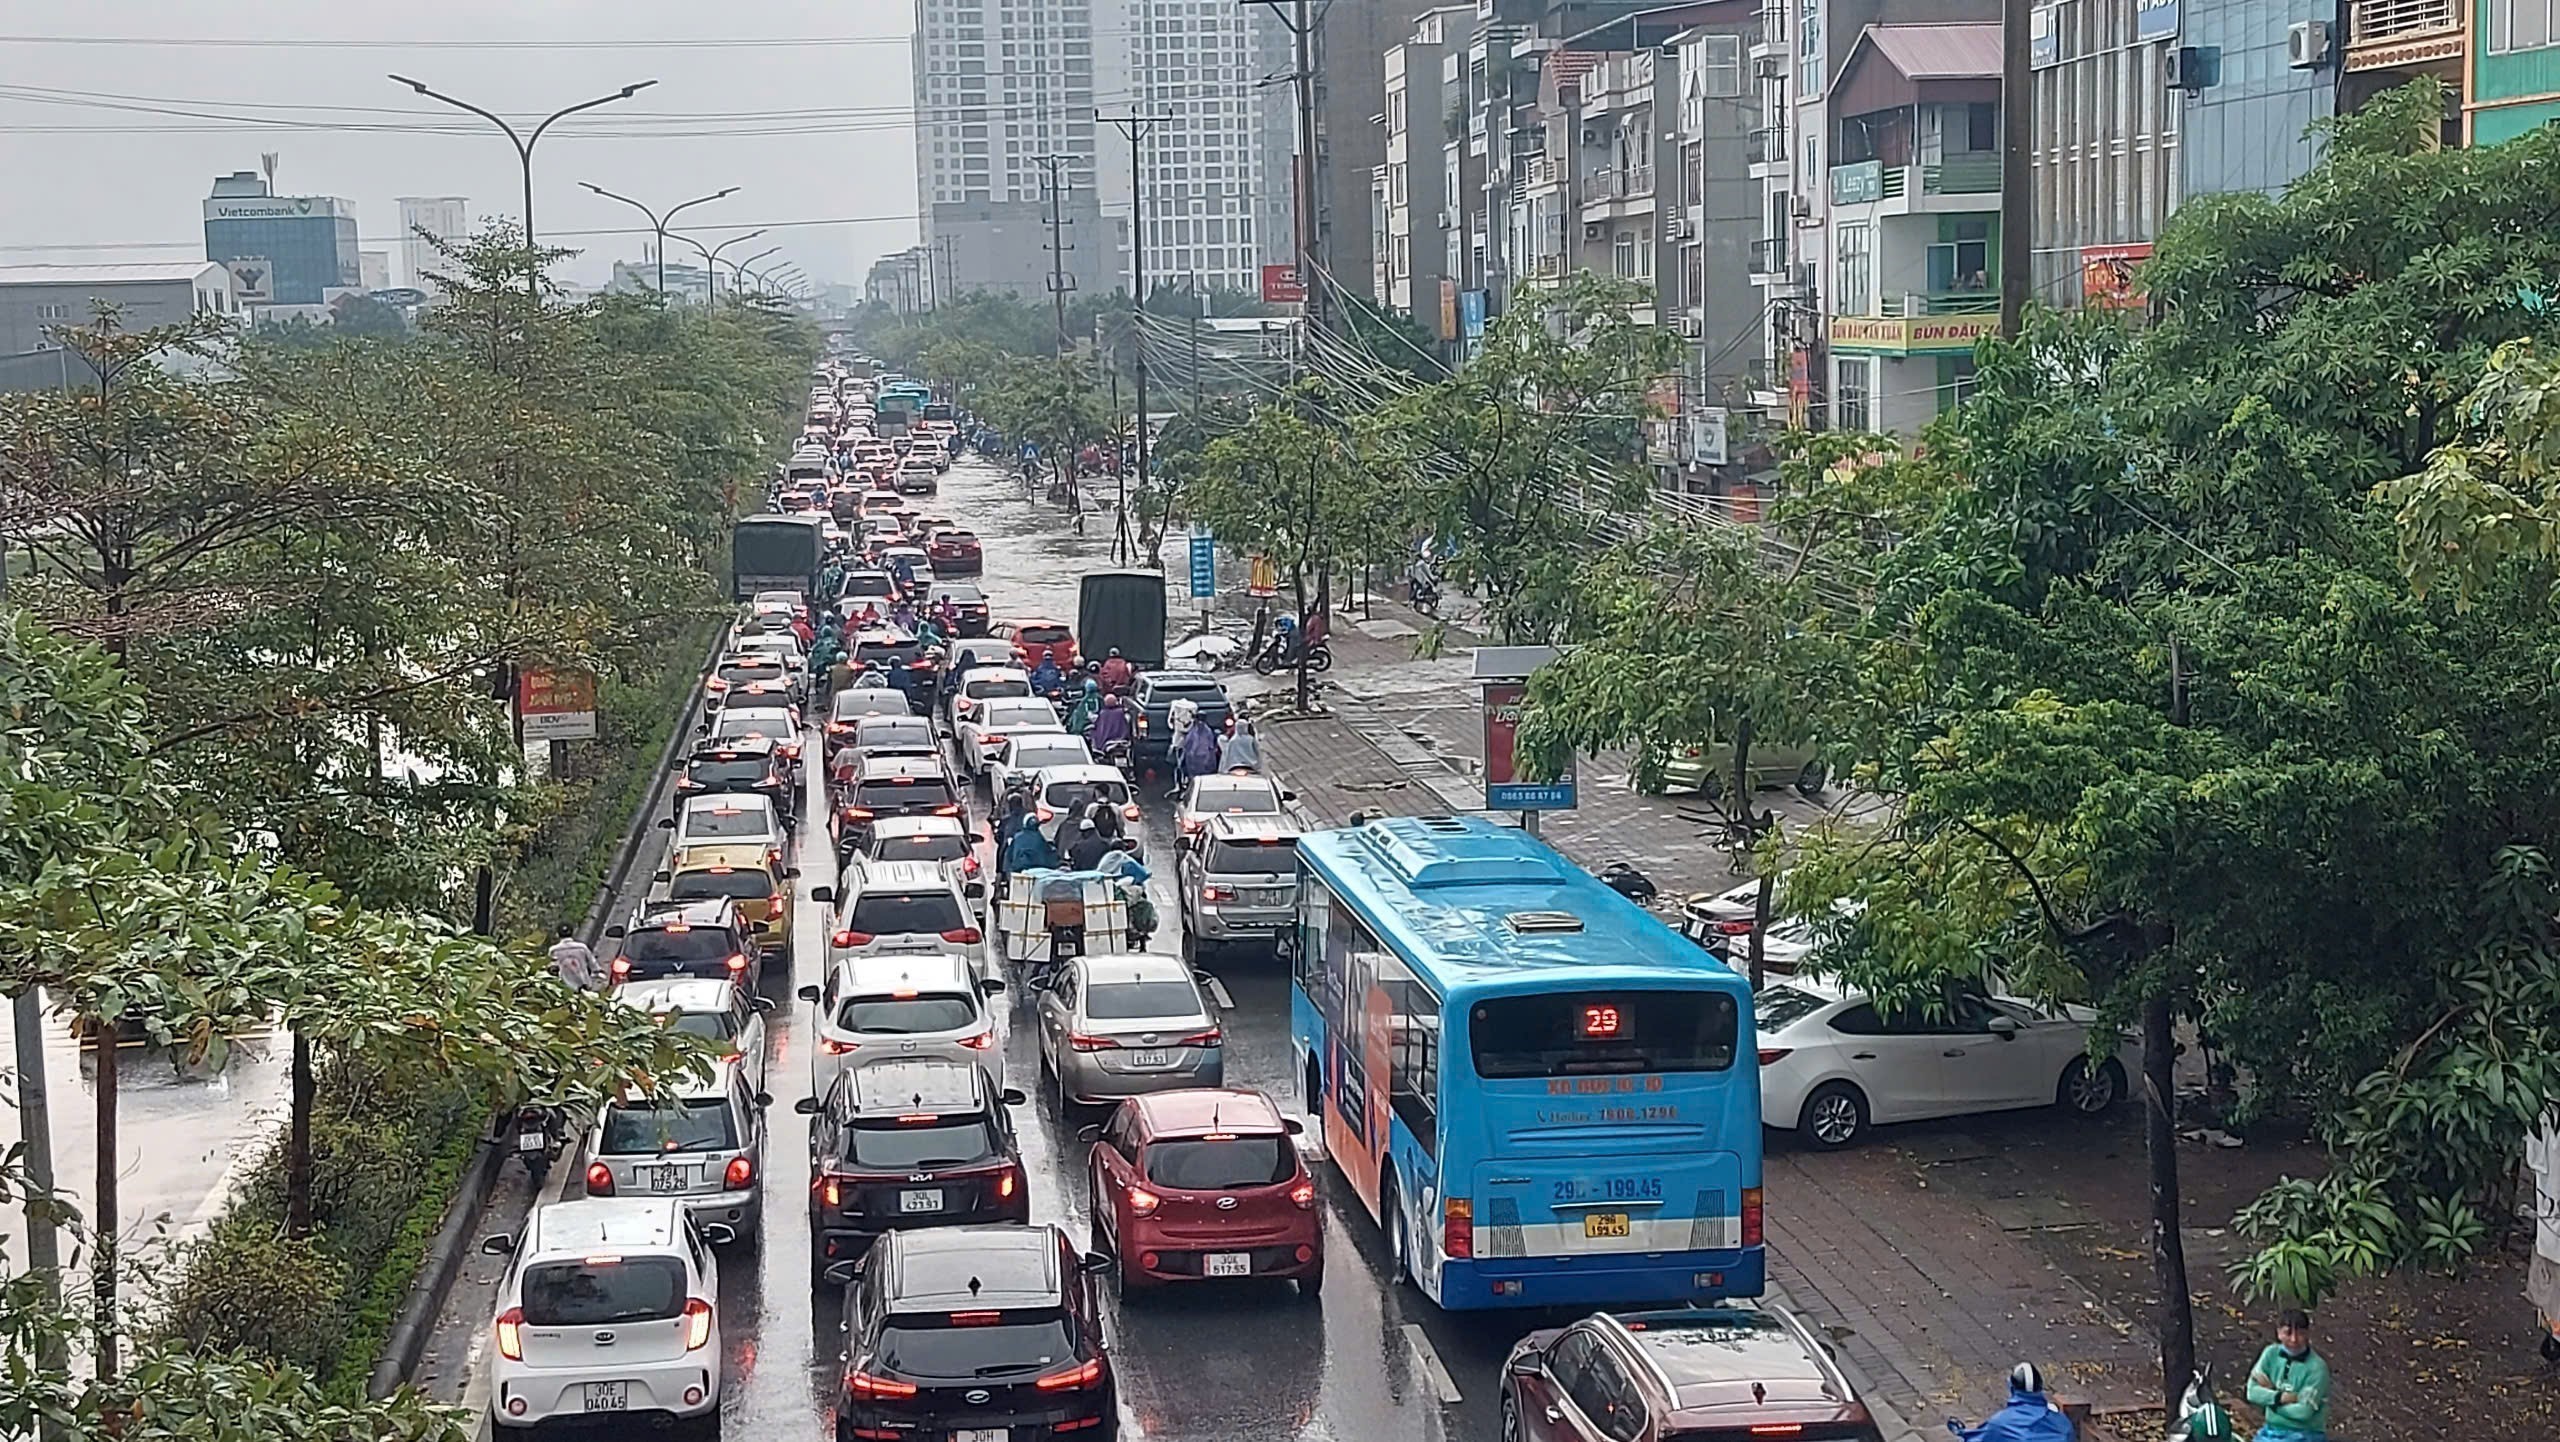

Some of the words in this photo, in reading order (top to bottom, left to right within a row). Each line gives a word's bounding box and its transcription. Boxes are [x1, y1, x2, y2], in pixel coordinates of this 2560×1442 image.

[218, 206, 295, 217] Vietcombank
[1913, 323, 1945, 340] BÚN
[1948, 322, 1980, 342] ĐẬU
[1586, 1008, 1618, 1032] 29
[1605, 1178, 1662, 1198] 199.45
[595, 1383, 617, 1397] 30E
[586, 1396, 625, 1411] 040.45
